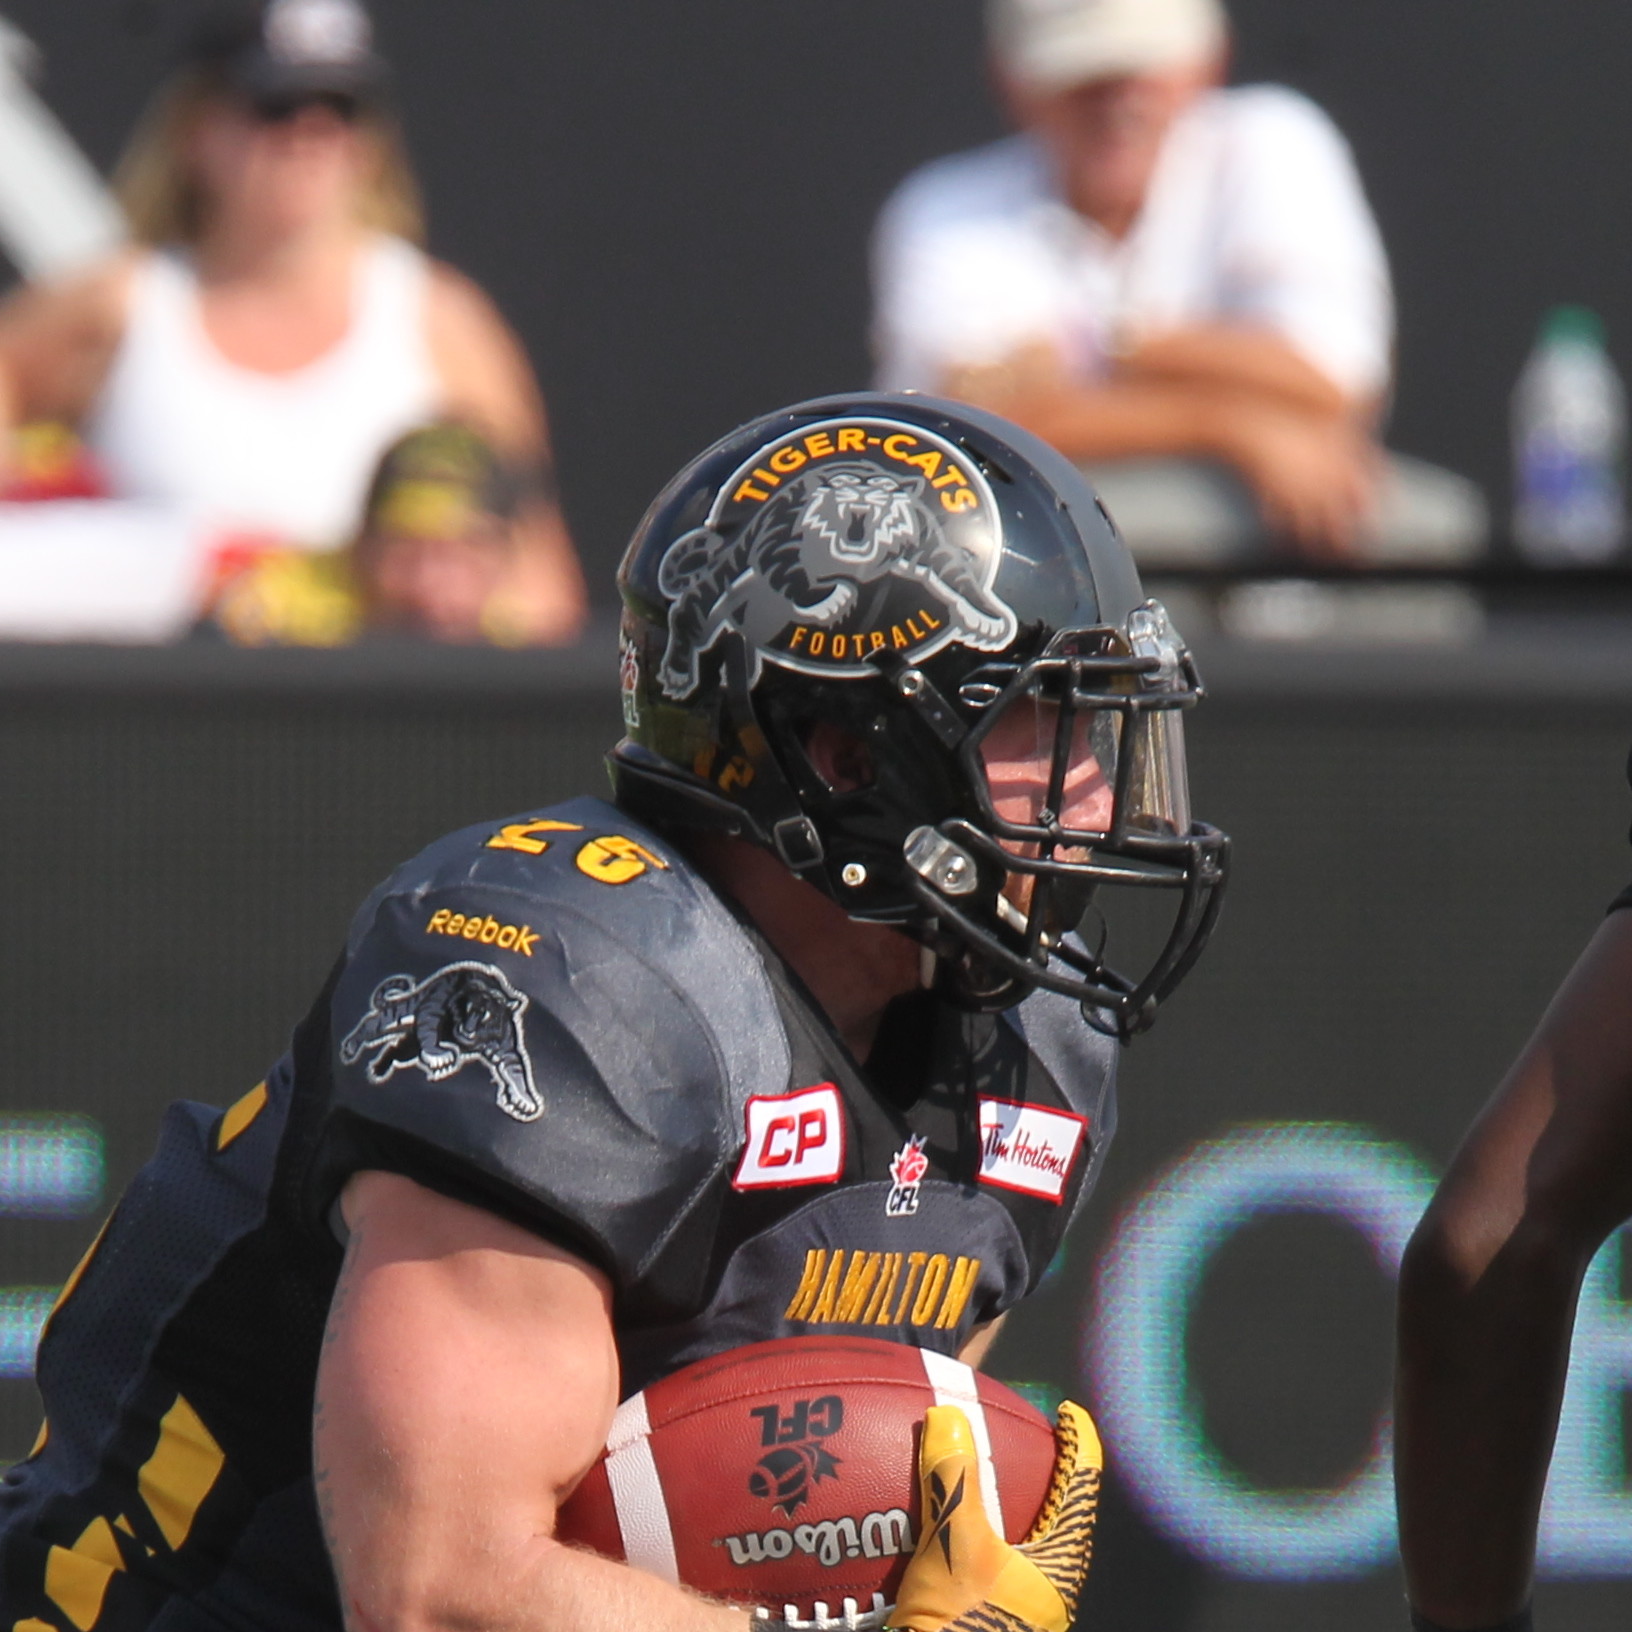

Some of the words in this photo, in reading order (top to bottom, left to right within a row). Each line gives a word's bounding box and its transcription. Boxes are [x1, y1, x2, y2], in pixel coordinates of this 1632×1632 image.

[732, 427, 978, 515] TIGER-CATS
[788, 608, 941, 660] FOOTBALL
[425, 907, 542, 958] Reebok
[756, 1107, 828, 1169] CP
[981, 1122, 1009, 1162] Tim
[1010, 1126, 1067, 1178] Hortons
[888, 1184, 917, 1213] CFL
[783, 1247, 982, 1330] HAMILTON
[749, 1394, 845, 1448] CFL
[723, 1506, 921, 1567] Wilson
